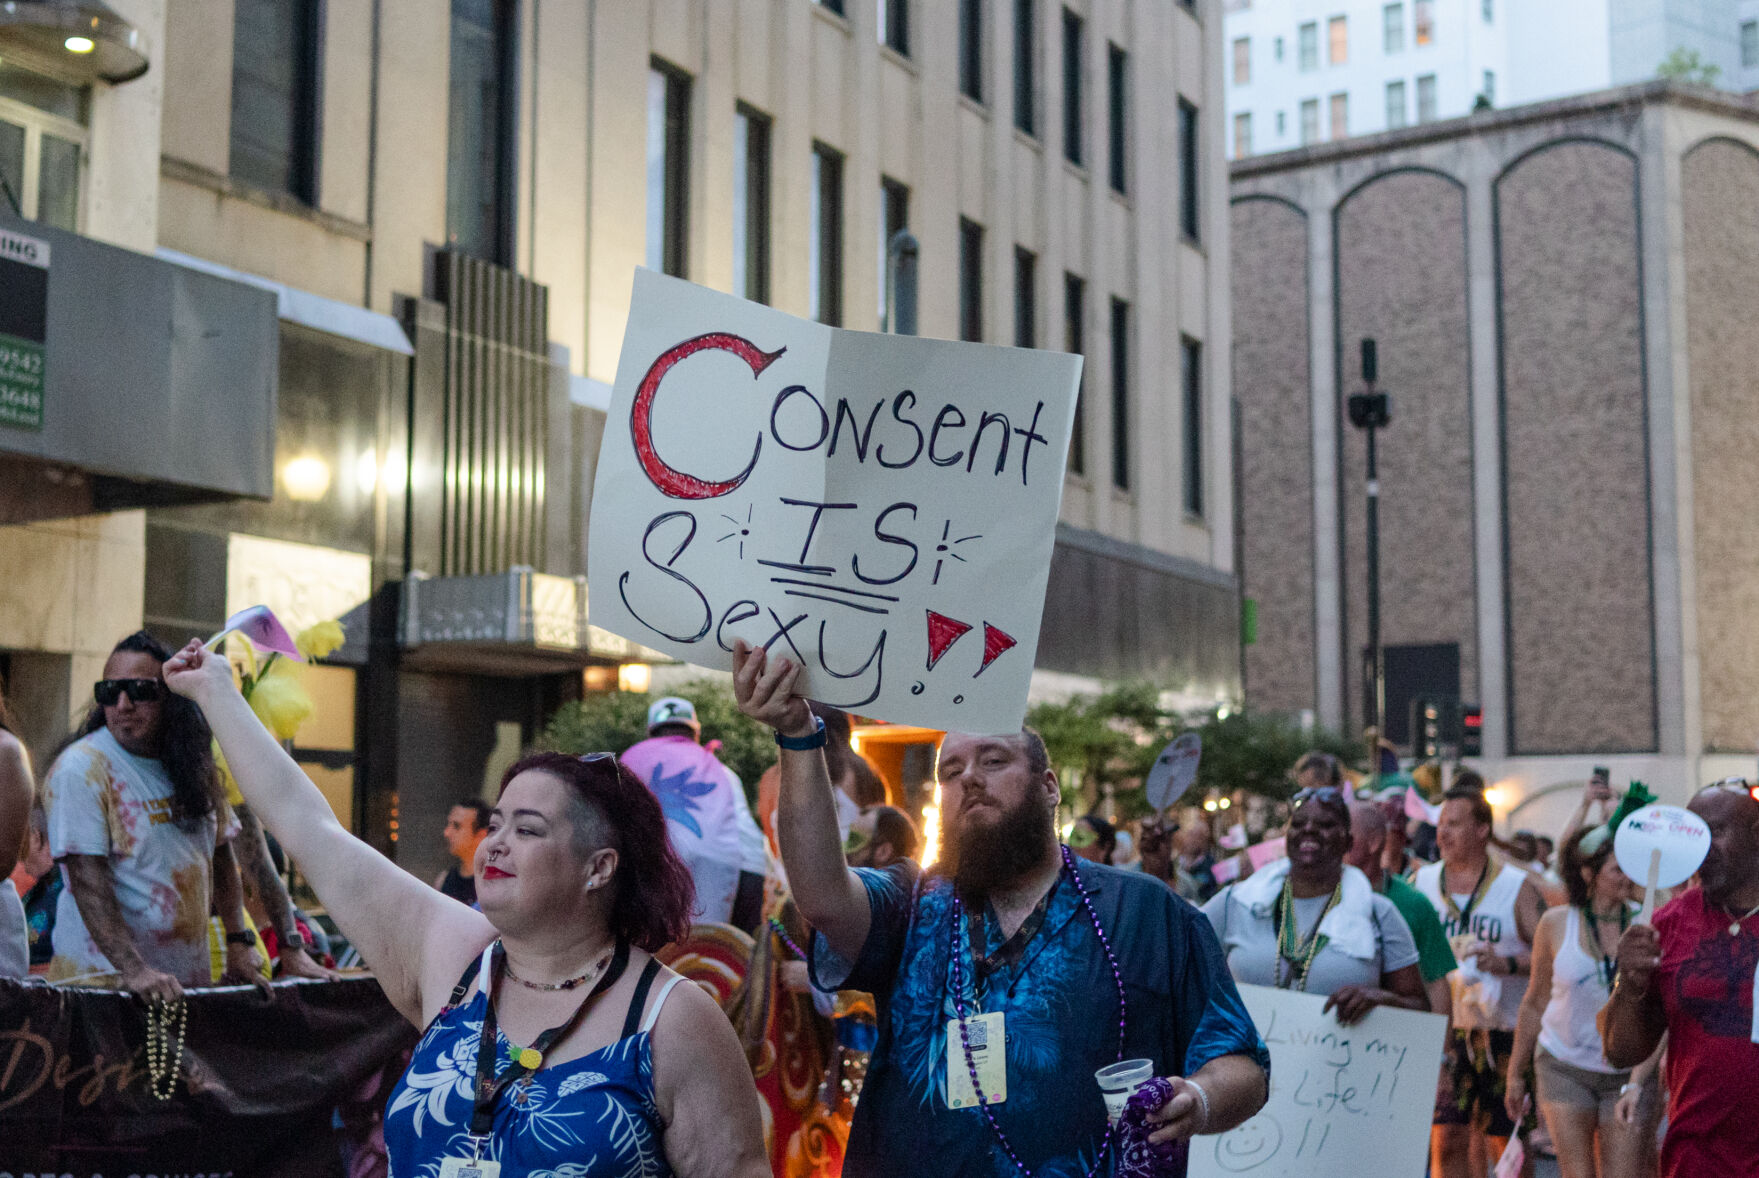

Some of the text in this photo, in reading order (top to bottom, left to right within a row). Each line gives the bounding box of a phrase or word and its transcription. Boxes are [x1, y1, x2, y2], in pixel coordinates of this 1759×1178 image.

[757, 497, 919, 585] IS
[1263, 1009, 1408, 1071] Living my
